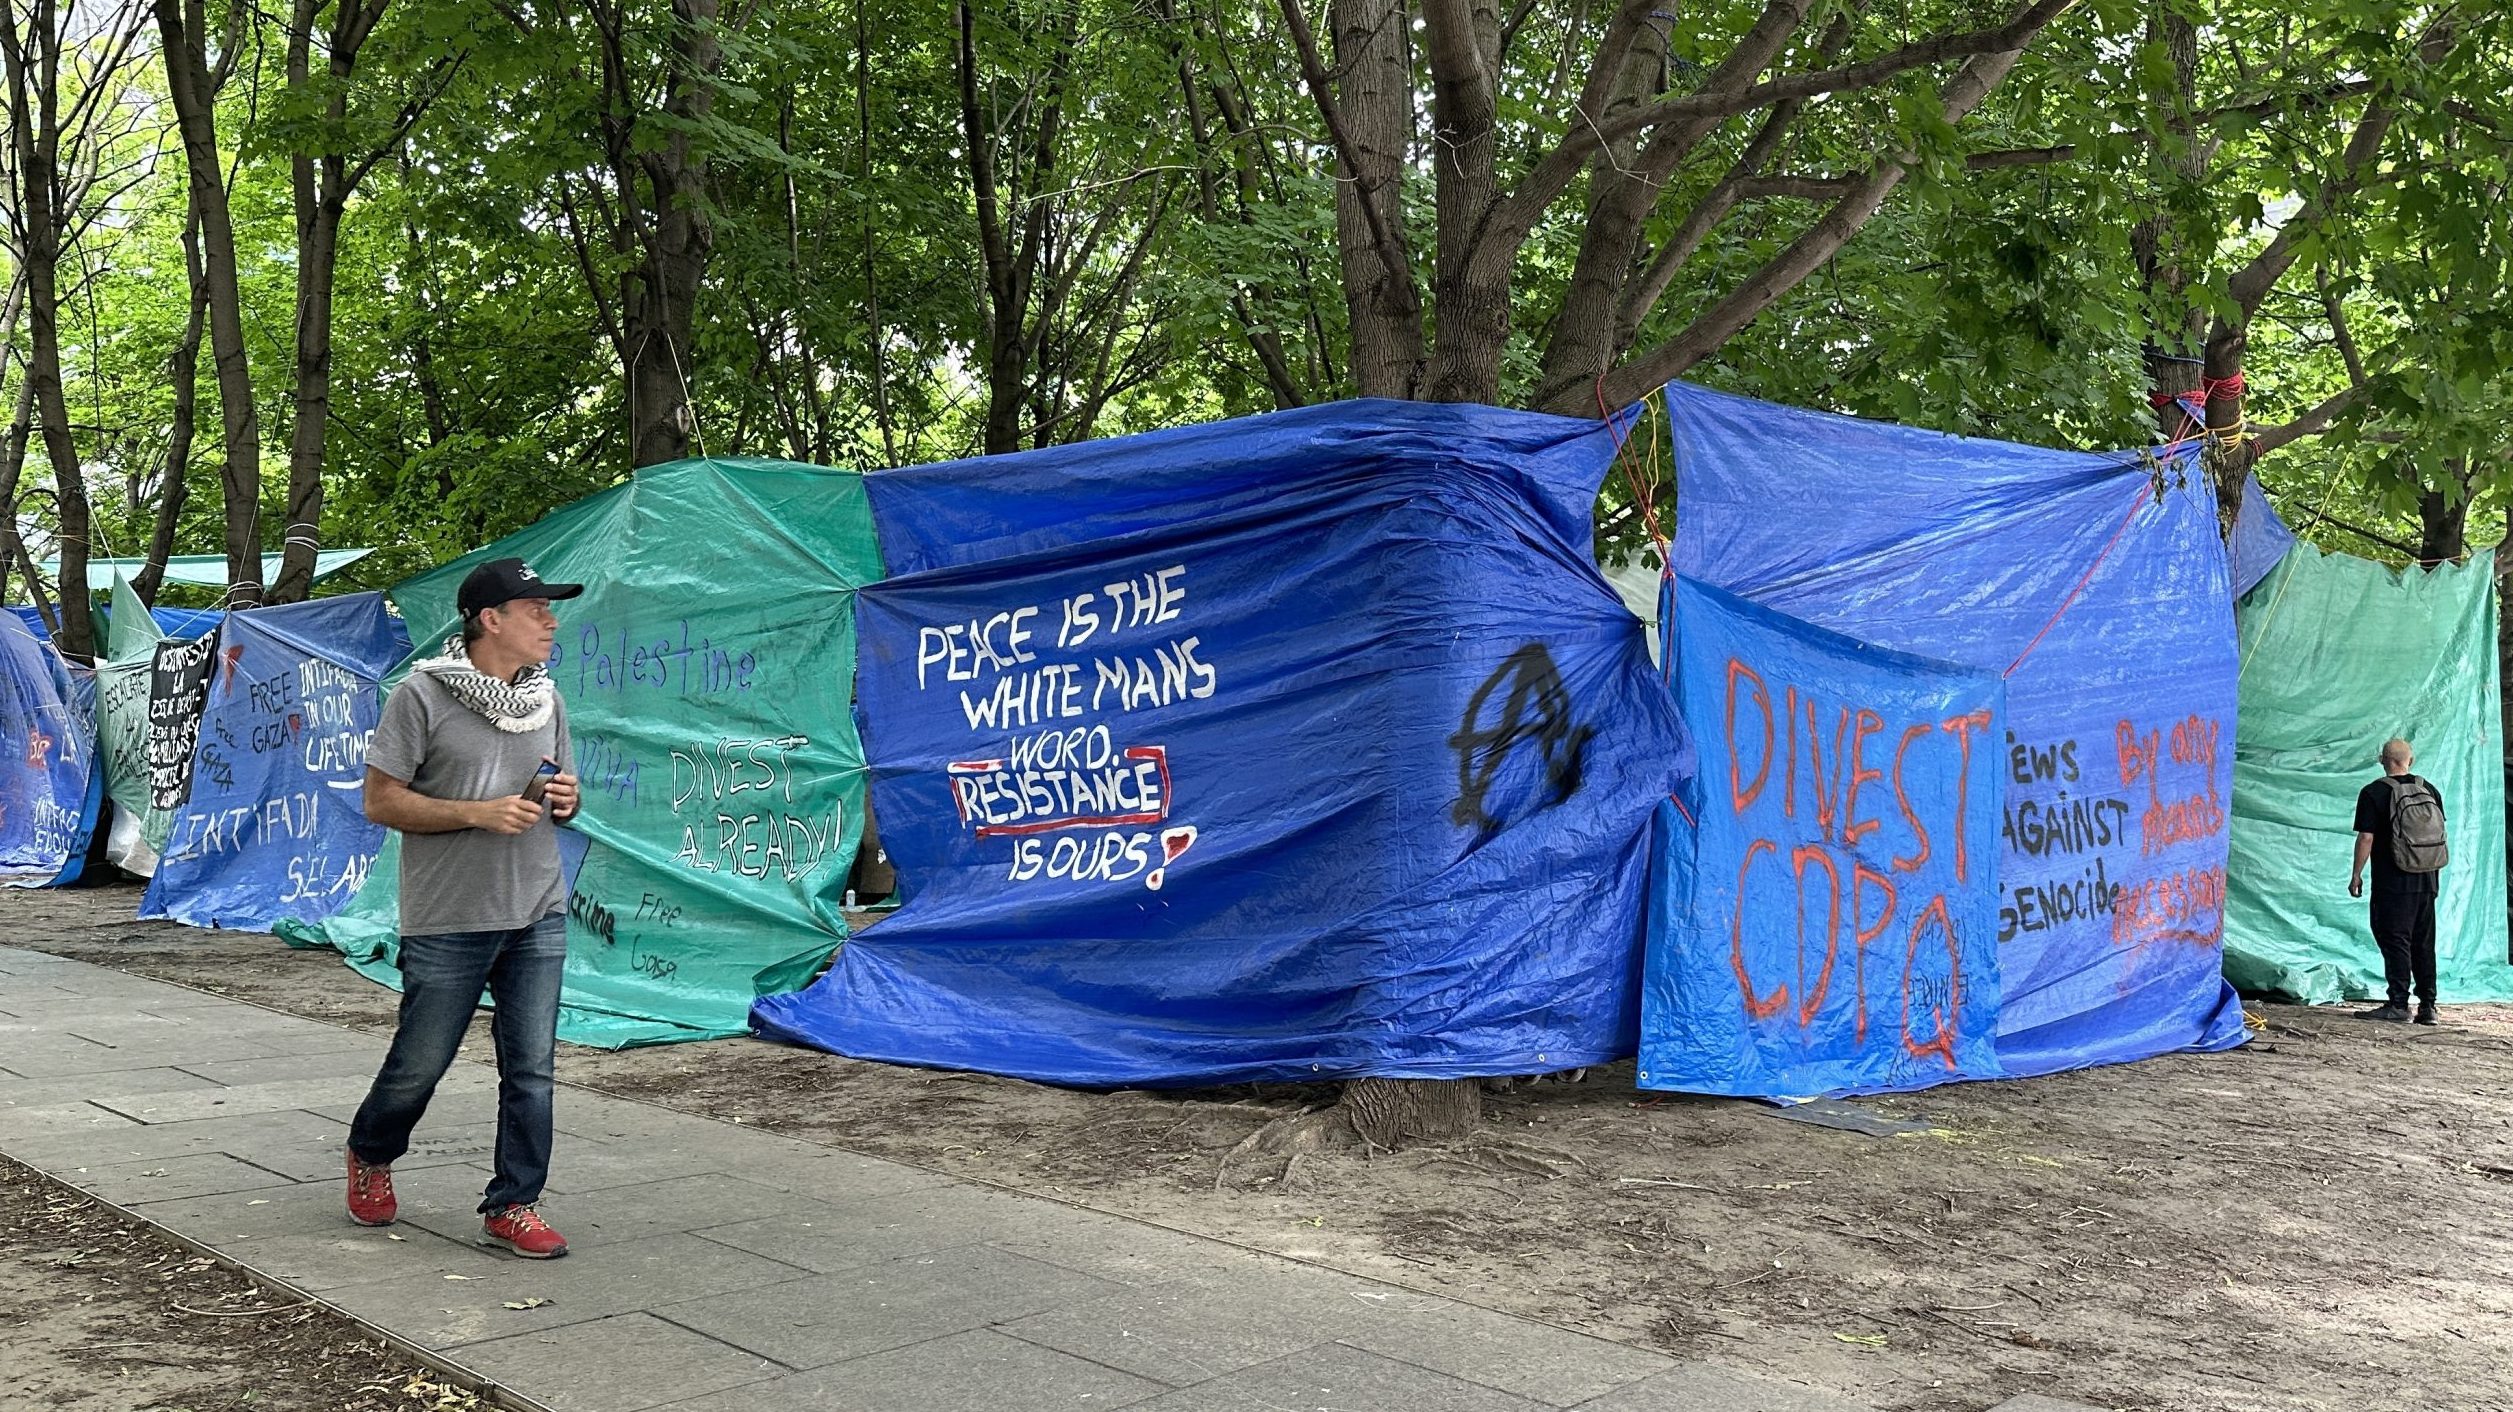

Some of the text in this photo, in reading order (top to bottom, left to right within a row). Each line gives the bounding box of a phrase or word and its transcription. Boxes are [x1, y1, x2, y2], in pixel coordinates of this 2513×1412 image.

[917, 565, 1185, 690] PEACE IS THE
[579, 619, 757, 698] Palestine
[961, 636, 1215, 730] WHITE MANS
[250, 671, 293, 714] FREE
[304, 692, 354, 729] IN OUR
[252, 719, 290, 754] GAZA
[1011, 724, 1120, 770] WORD.
[2006, 730, 2080, 784] EWS
[669, 735, 809, 815] DIVEST
[960, 762, 1162, 824] RESISTANCE
[1725, 656, 1993, 884] DIVEST
[668, 798, 843, 884] ALREADY!
[1008, 839, 1043, 881] IS
[570, 890, 615, 945] crime
[635, 892, 682, 928] Free
[1730, 838, 1961, 1072] CDPQ
